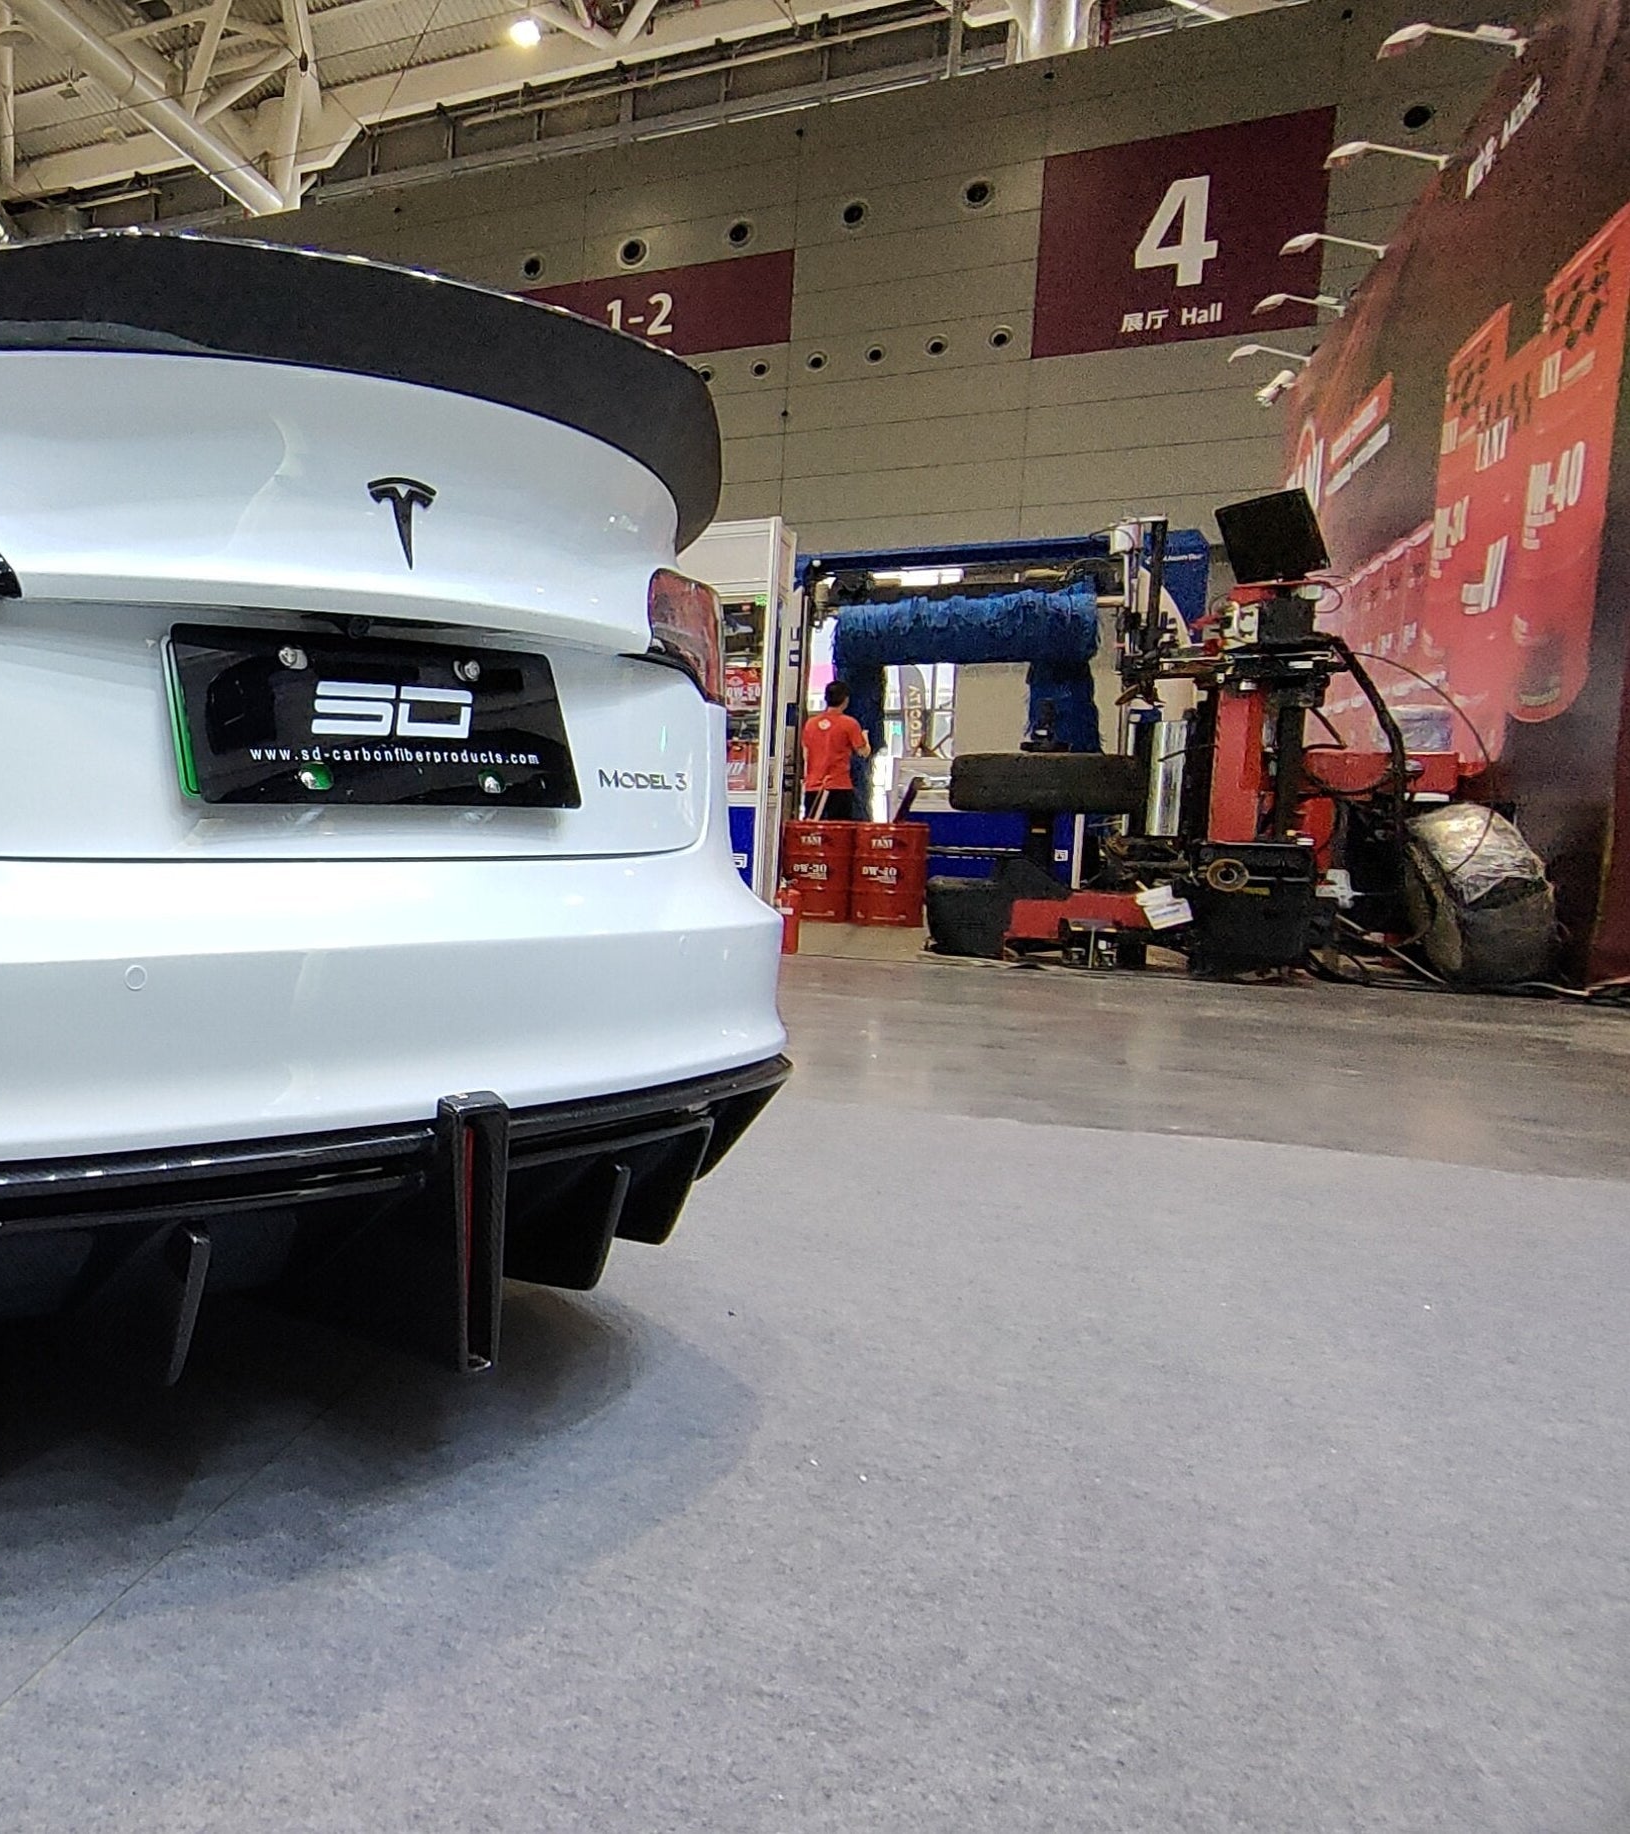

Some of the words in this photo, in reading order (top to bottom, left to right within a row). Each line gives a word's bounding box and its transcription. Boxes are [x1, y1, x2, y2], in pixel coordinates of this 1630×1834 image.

[1134, 175, 1218, 287] 4
[607, 293, 673, 335] 1-2
[1120, 309, 1169, 333] 展厅
[1181, 302, 1223, 325] Hall
[250, 747, 539, 765] www.sd-carbonfiberproducts.com
[598, 769, 670, 790] MODEL
[674, 773, 687, 791] 3
